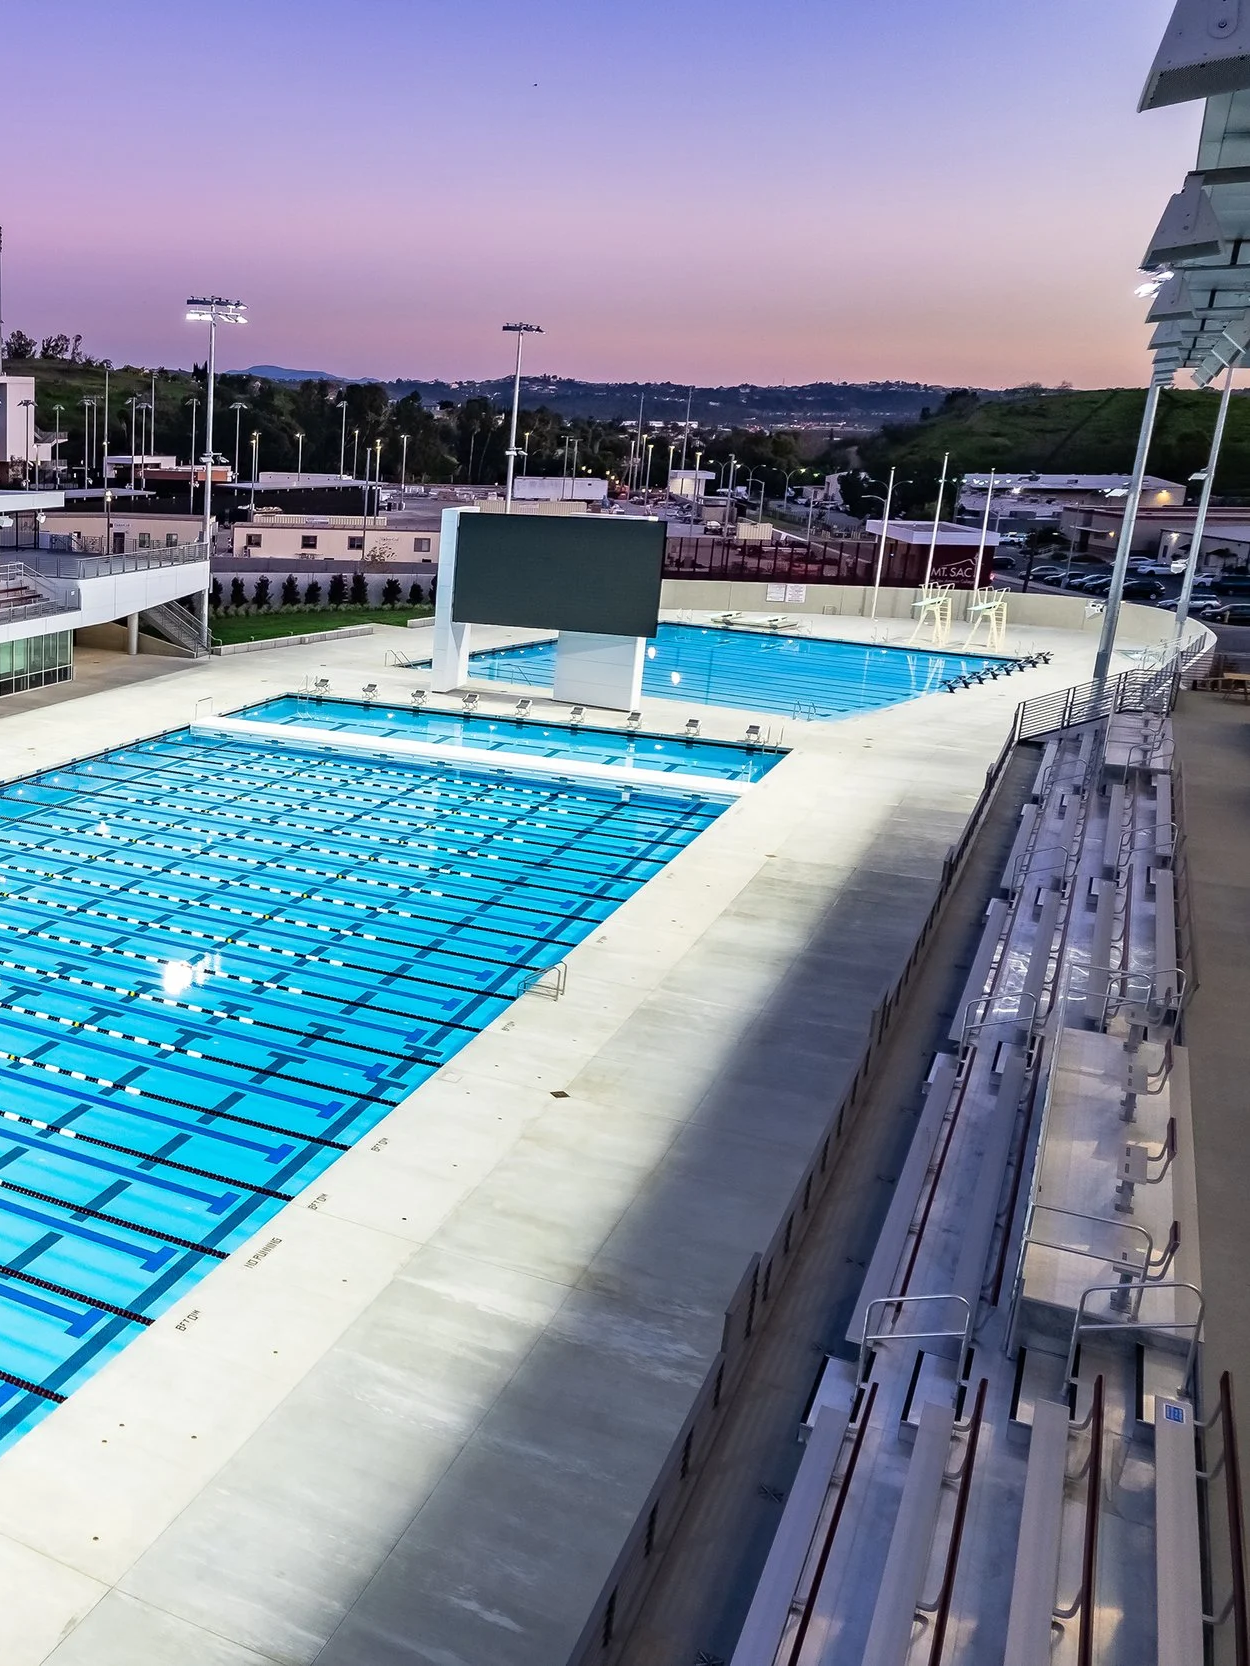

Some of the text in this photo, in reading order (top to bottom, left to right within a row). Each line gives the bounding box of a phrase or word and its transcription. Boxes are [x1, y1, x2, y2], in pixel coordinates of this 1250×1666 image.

[930, 567, 973, 578] MT. SAC
[244, 1237, 282, 1269] NO RUNNING
